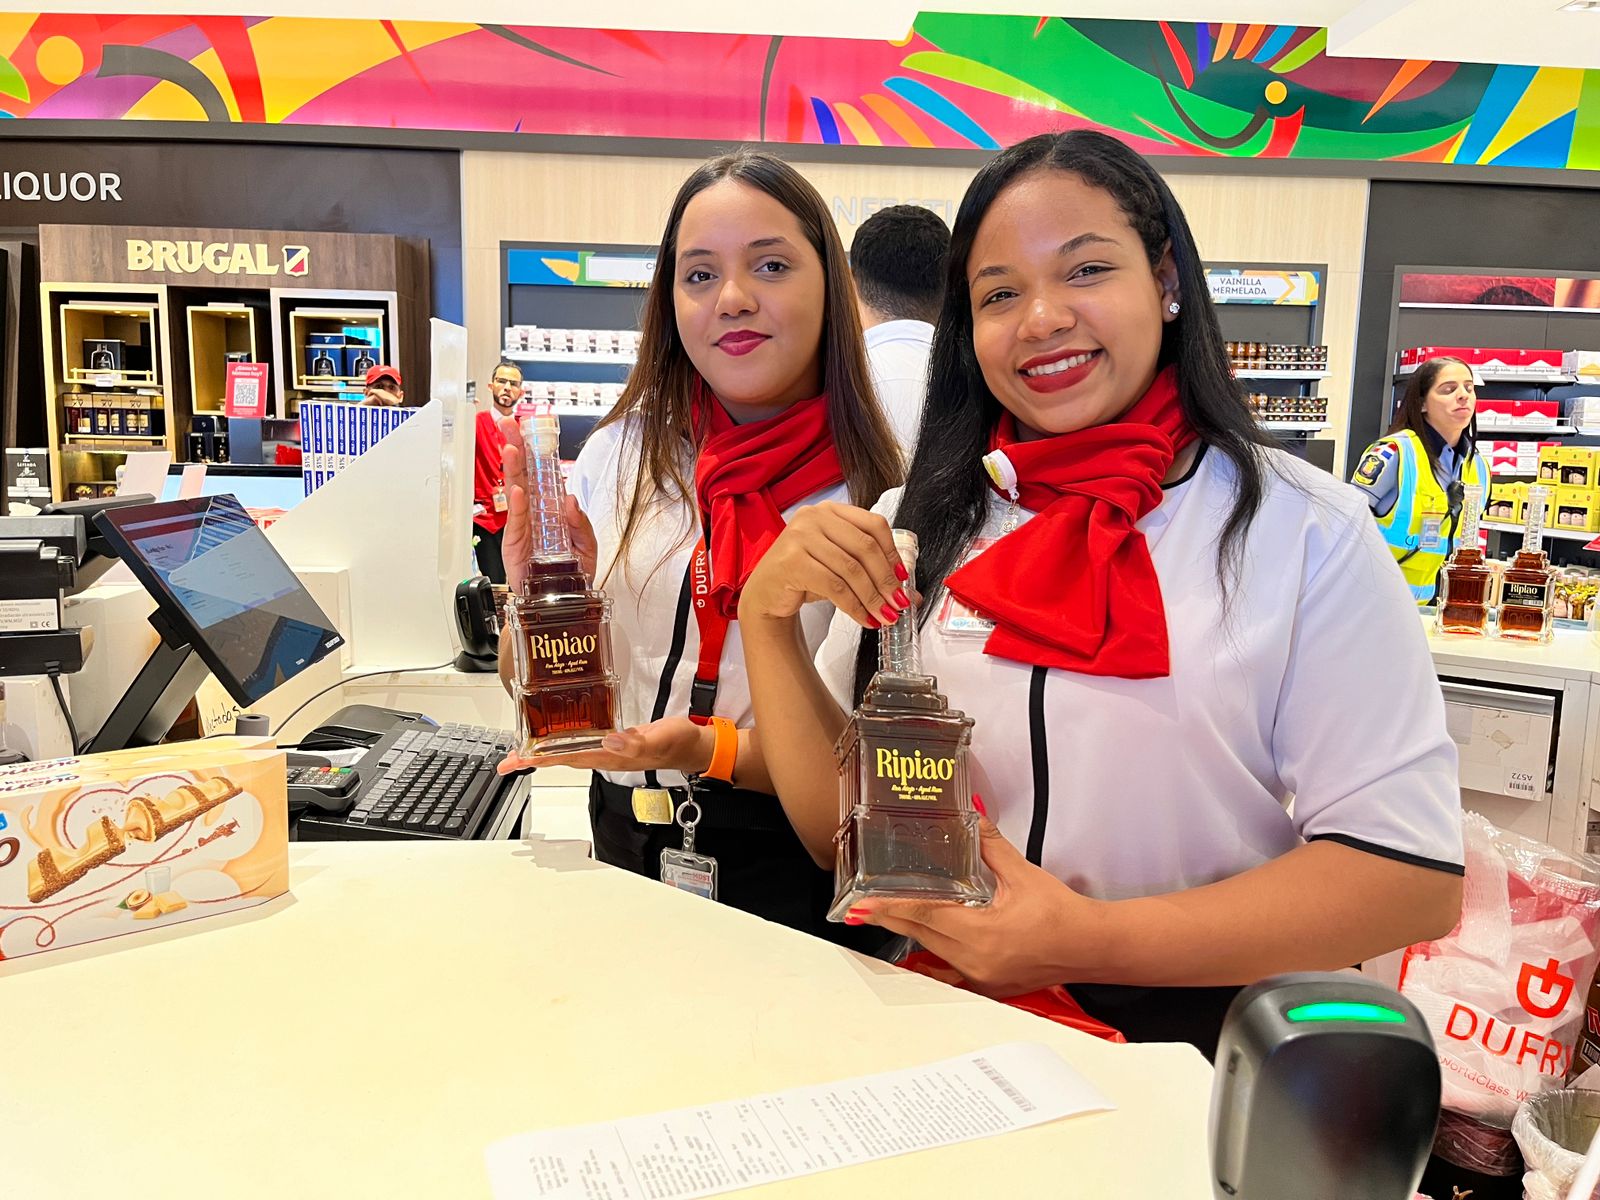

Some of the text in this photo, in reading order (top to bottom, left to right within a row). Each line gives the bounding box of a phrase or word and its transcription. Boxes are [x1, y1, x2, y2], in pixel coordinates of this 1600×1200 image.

[0, 171, 122, 201] IQUOR
[126, 239, 280, 275] BRUGAL
[1212, 286, 1267, 295] MERMELADA
[1220, 278, 1261, 286] VAINILLA
[696, 550, 708, 594] DUFRY
[1510, 583, 1538, 595] Ripiao
[530, 632, 597, 663] Ripiao
[876, 748, 955, 786] Ripiao
[1511, 772, 1533, 782] A572
